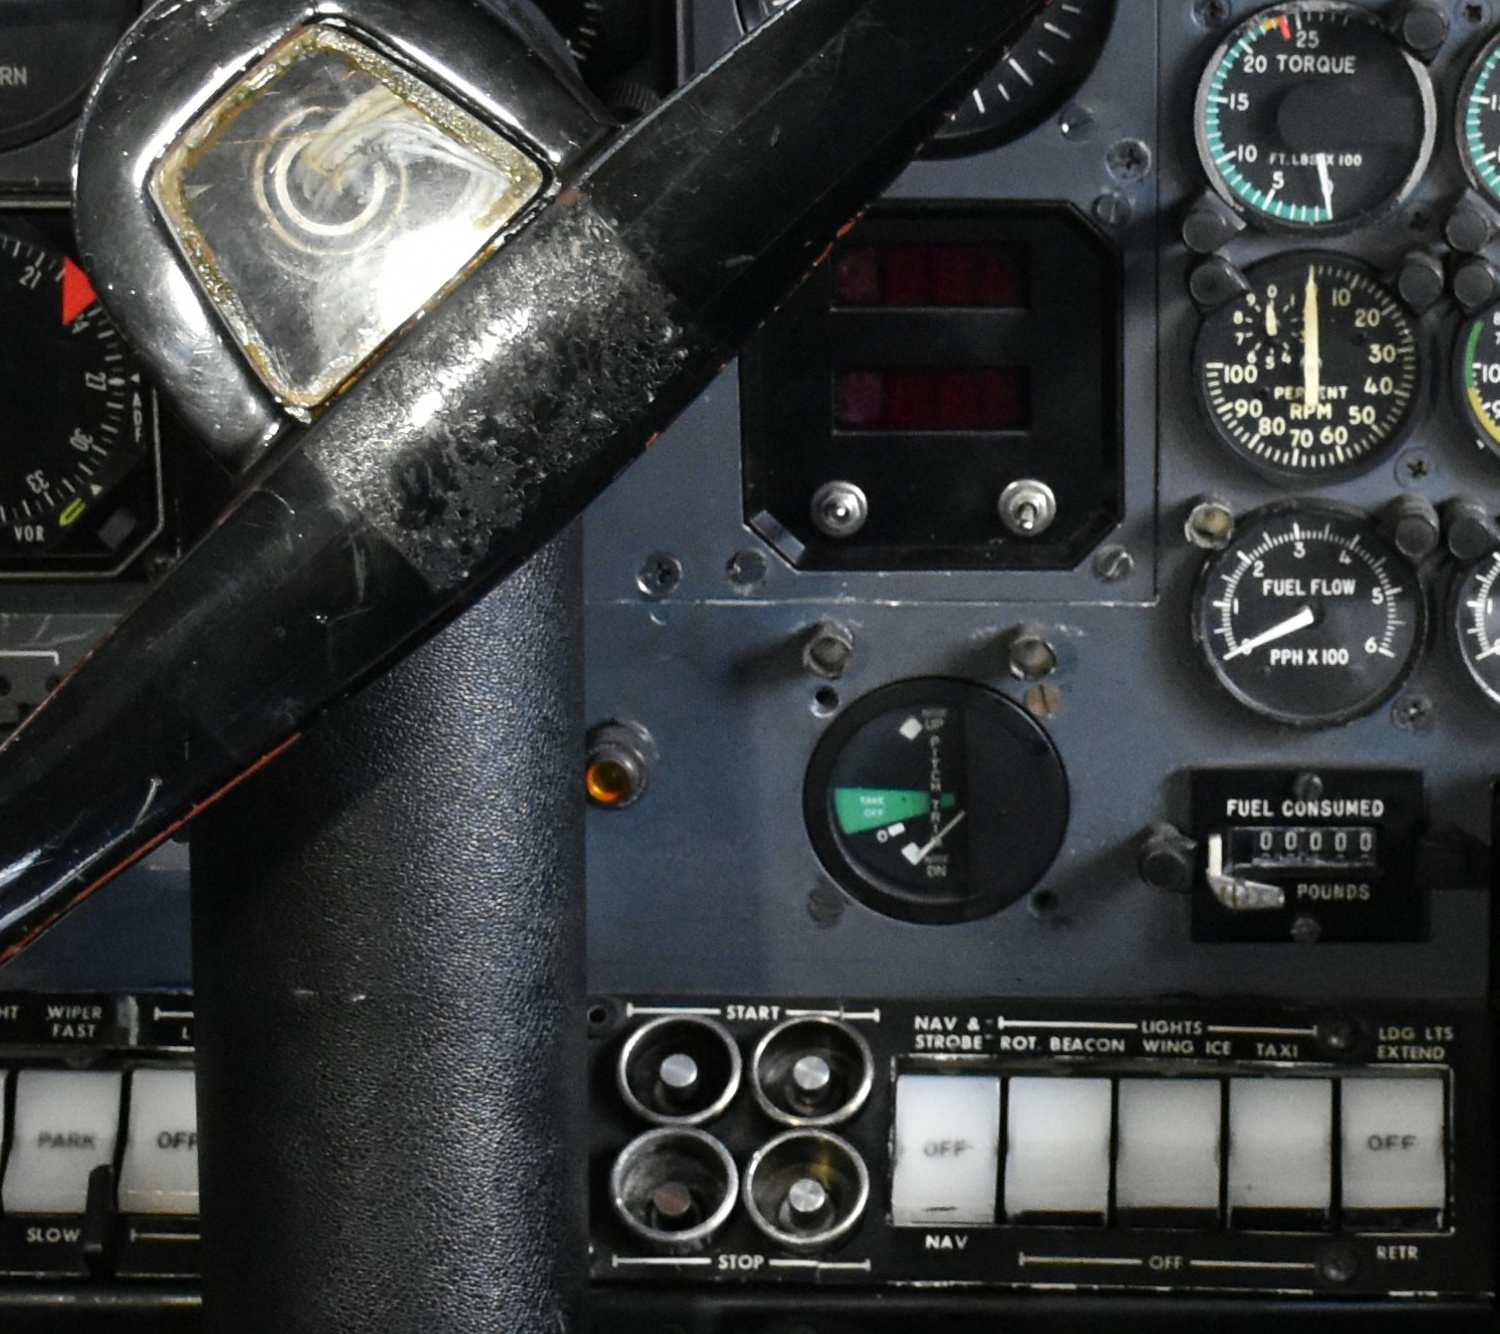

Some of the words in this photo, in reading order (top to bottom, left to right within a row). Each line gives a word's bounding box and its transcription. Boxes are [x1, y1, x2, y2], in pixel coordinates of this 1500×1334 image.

[1275, 53, 1355, 74] TORQUE
[1262, 578, 1306, 597] FUEL
[1310, 578, 1356, 596] FLOW
[1269, 648, 1304, 666] PPH
[1307, 648, 1319, 665] X
[1321, 647, 1350, 666] 100
[1226, 798, 1274, 818] FUEL
[1281, 799, 1385, 818] CONSUMED
[1296, 883, 1370, 901] POUNDS
[726, 1004, 780, 1021] START
[1141, 1019, 1203, 1035] LIGHTS
[1049, 1036, 1125, 1052] BEACON
[1256, 1042, 1298, 1058] TAXI
[1377, 1045, 1445, 1060] EXTEND
[718, 1254, 765, 1270] STOP
